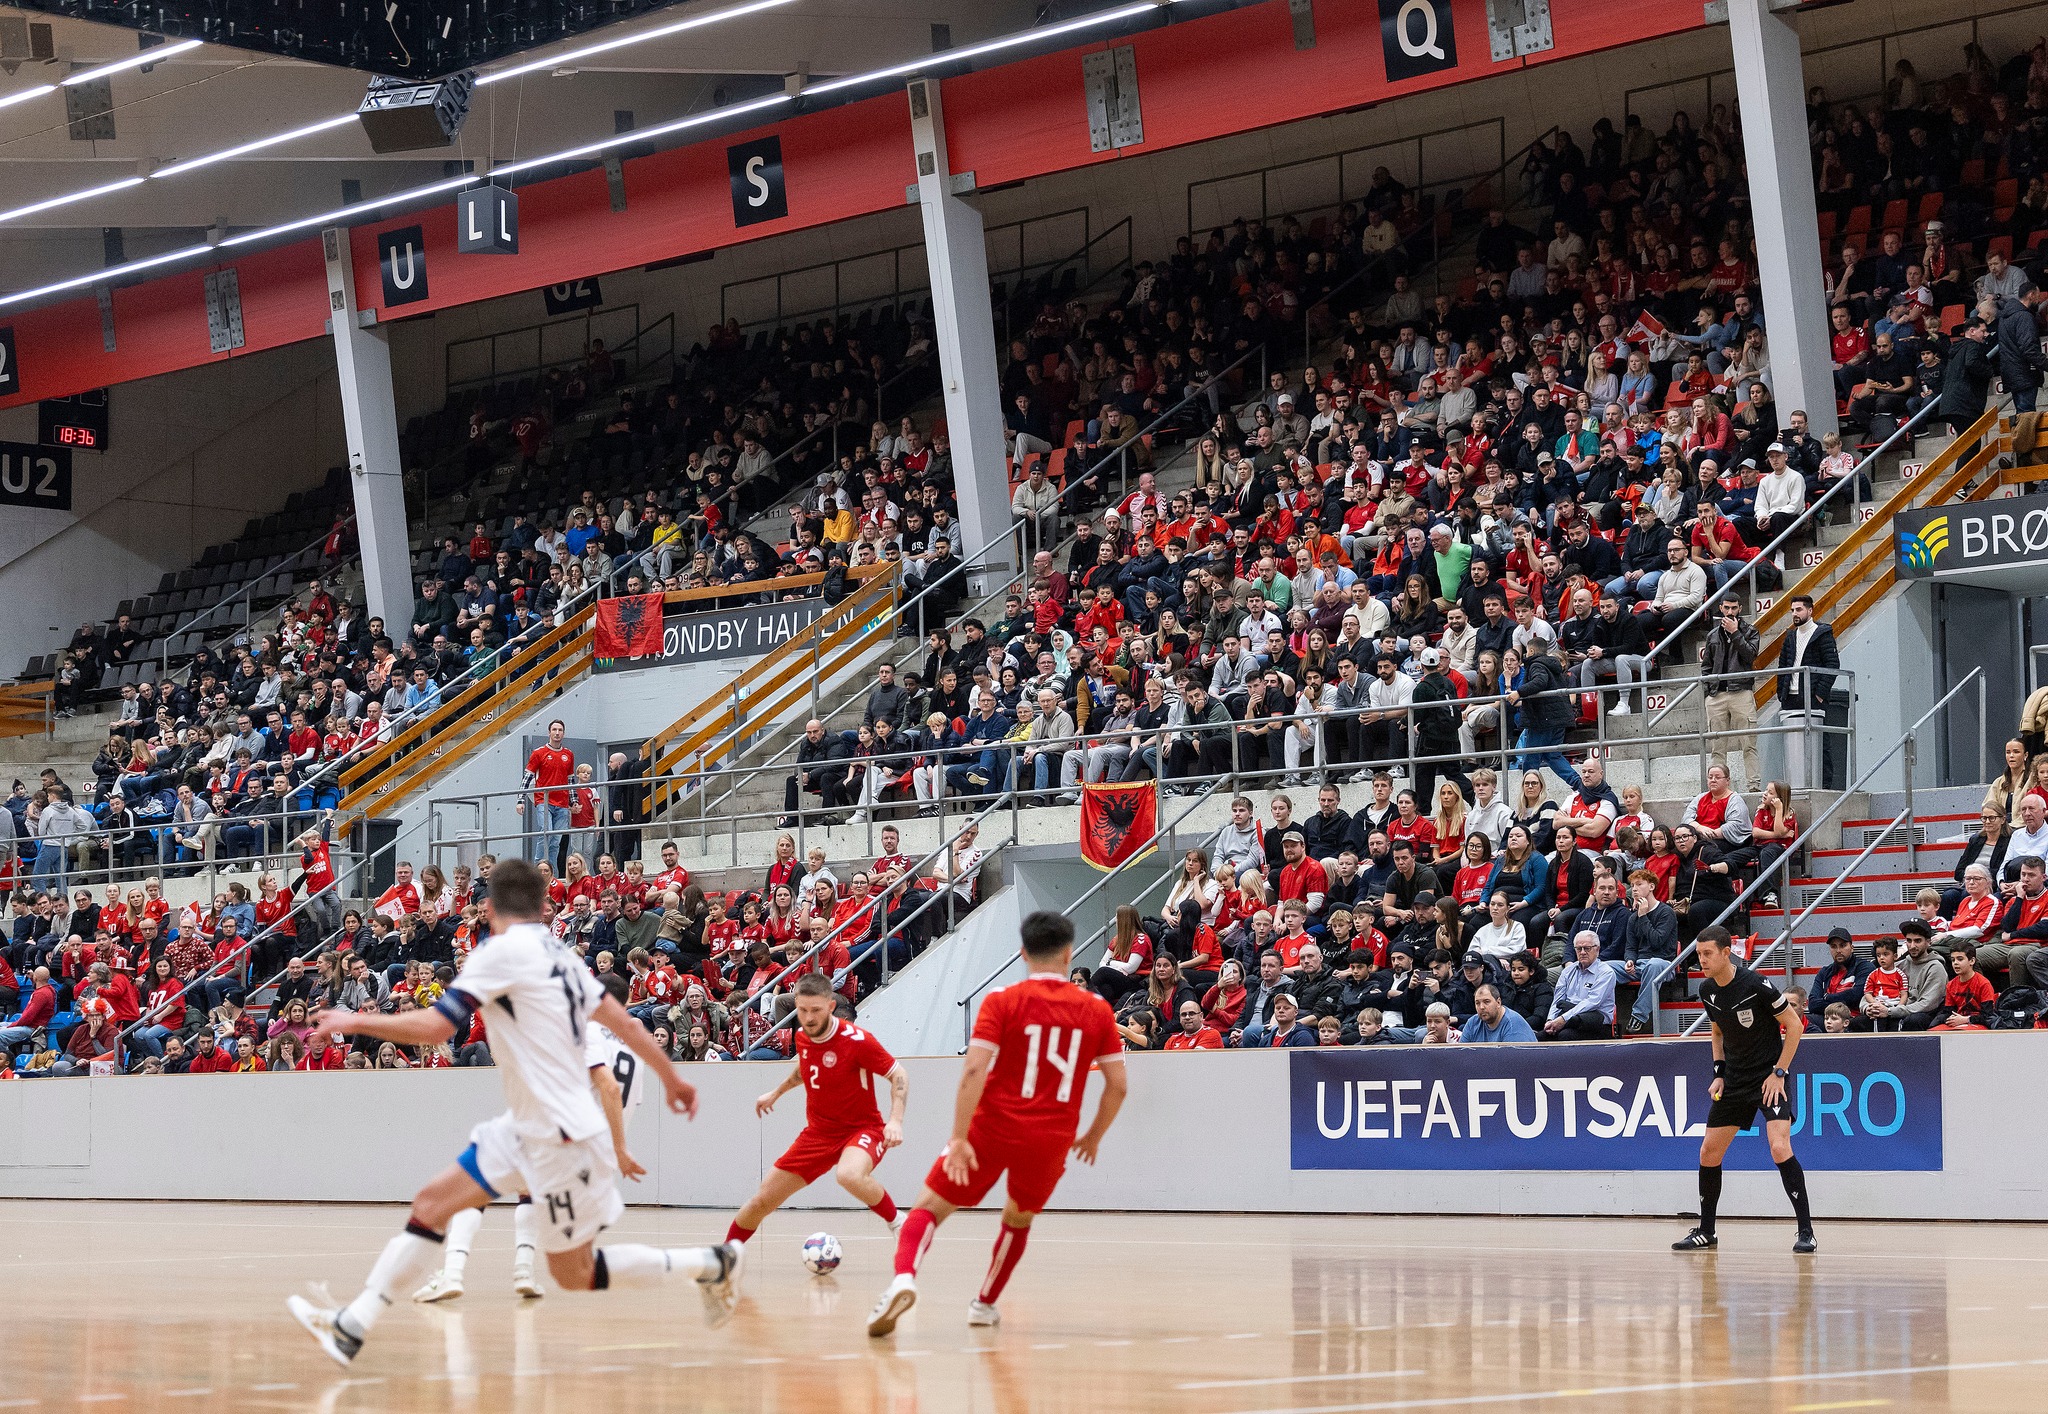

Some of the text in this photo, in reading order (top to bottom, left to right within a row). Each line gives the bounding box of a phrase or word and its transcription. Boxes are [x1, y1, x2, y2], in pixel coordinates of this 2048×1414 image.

[1396, 0, 1446, 60] Q
[745, 156, 769, 207] S
[468, 201, 483, 241] L
[500, 199, 512, 242] L
[390, 242, 415, 290] U
[60, 427, 94, 446] 18:36
[2, 453, 58, 497] U2
[1903, 464, 1923, 478] 07
[770, 509, 781, 519] 11
[1803, 553, 1823, 566] 05
[678, 573, 689, 585] 09
[1010, 583, 1023, 595] 02
[1647, 695, 1666, 709] 02
[269, 859, 280, 868] 01
[1023, 1024, 1083, 1103] 14
[809, 1065, 820, 1089] 2
[1316, 1080, 1461, 1140] UEFA
[1468, 1074, 1708, 1140] FUTSAL
[858, 1134, 871, 1148] 2
[545, 1190, 575, 1224] 14
